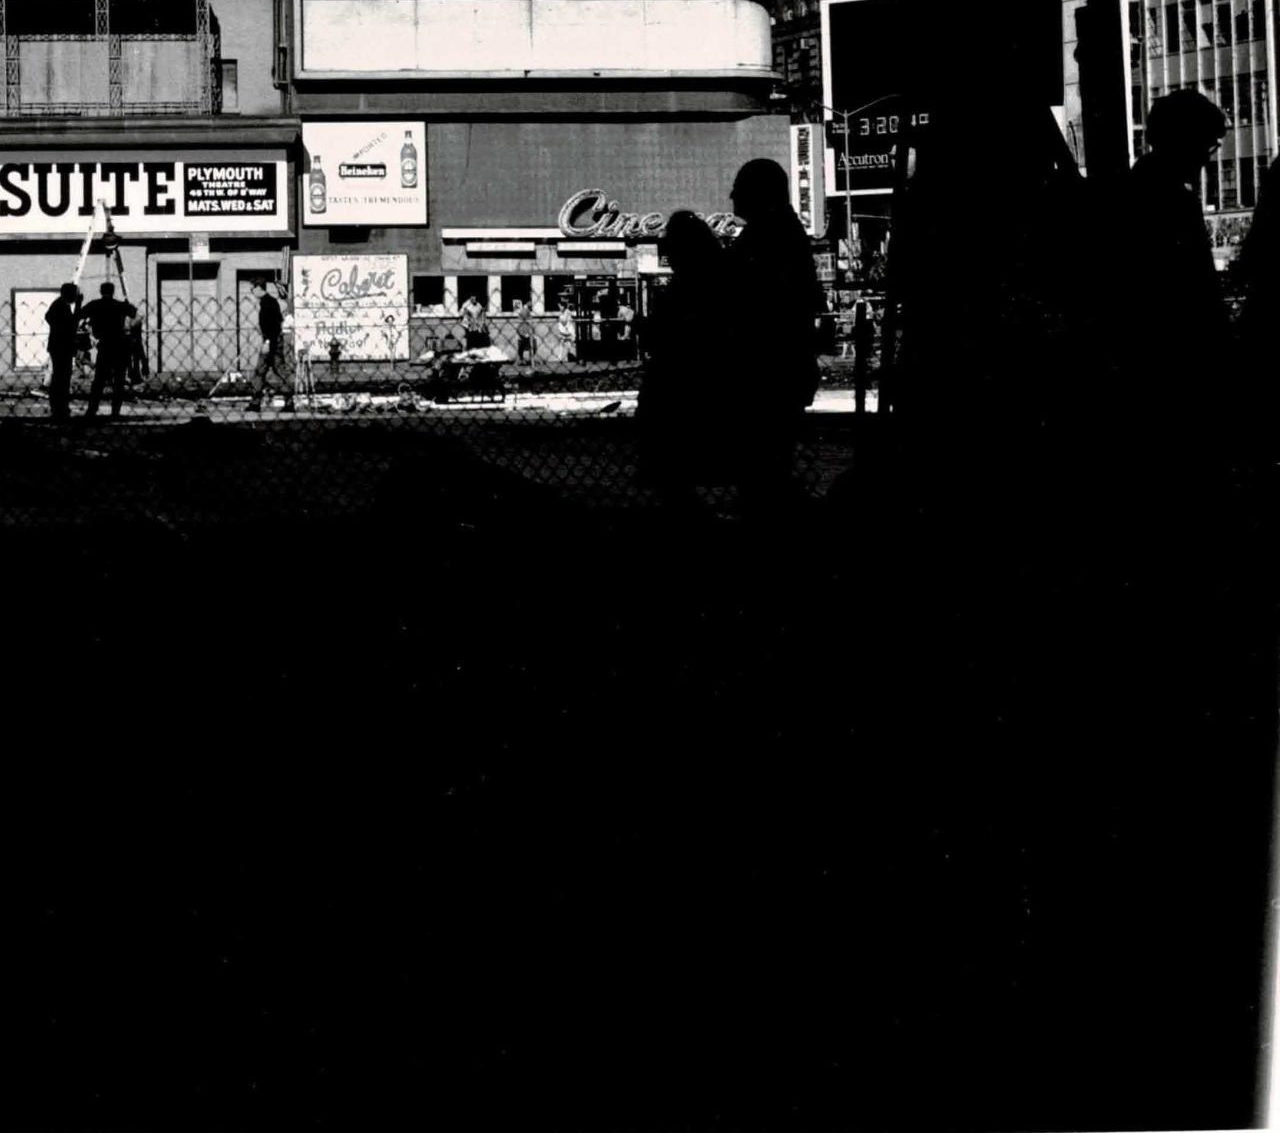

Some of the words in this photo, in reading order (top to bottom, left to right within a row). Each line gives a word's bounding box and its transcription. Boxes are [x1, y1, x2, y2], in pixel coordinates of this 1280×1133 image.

[837, 152, 889, 166] Accutron
[188, 167, 263, 181] PLYMOUTH
[221, 200, 245, 211] WED
[246, 202, 253, 211] &
[253, 199, 274, 211] SAT
